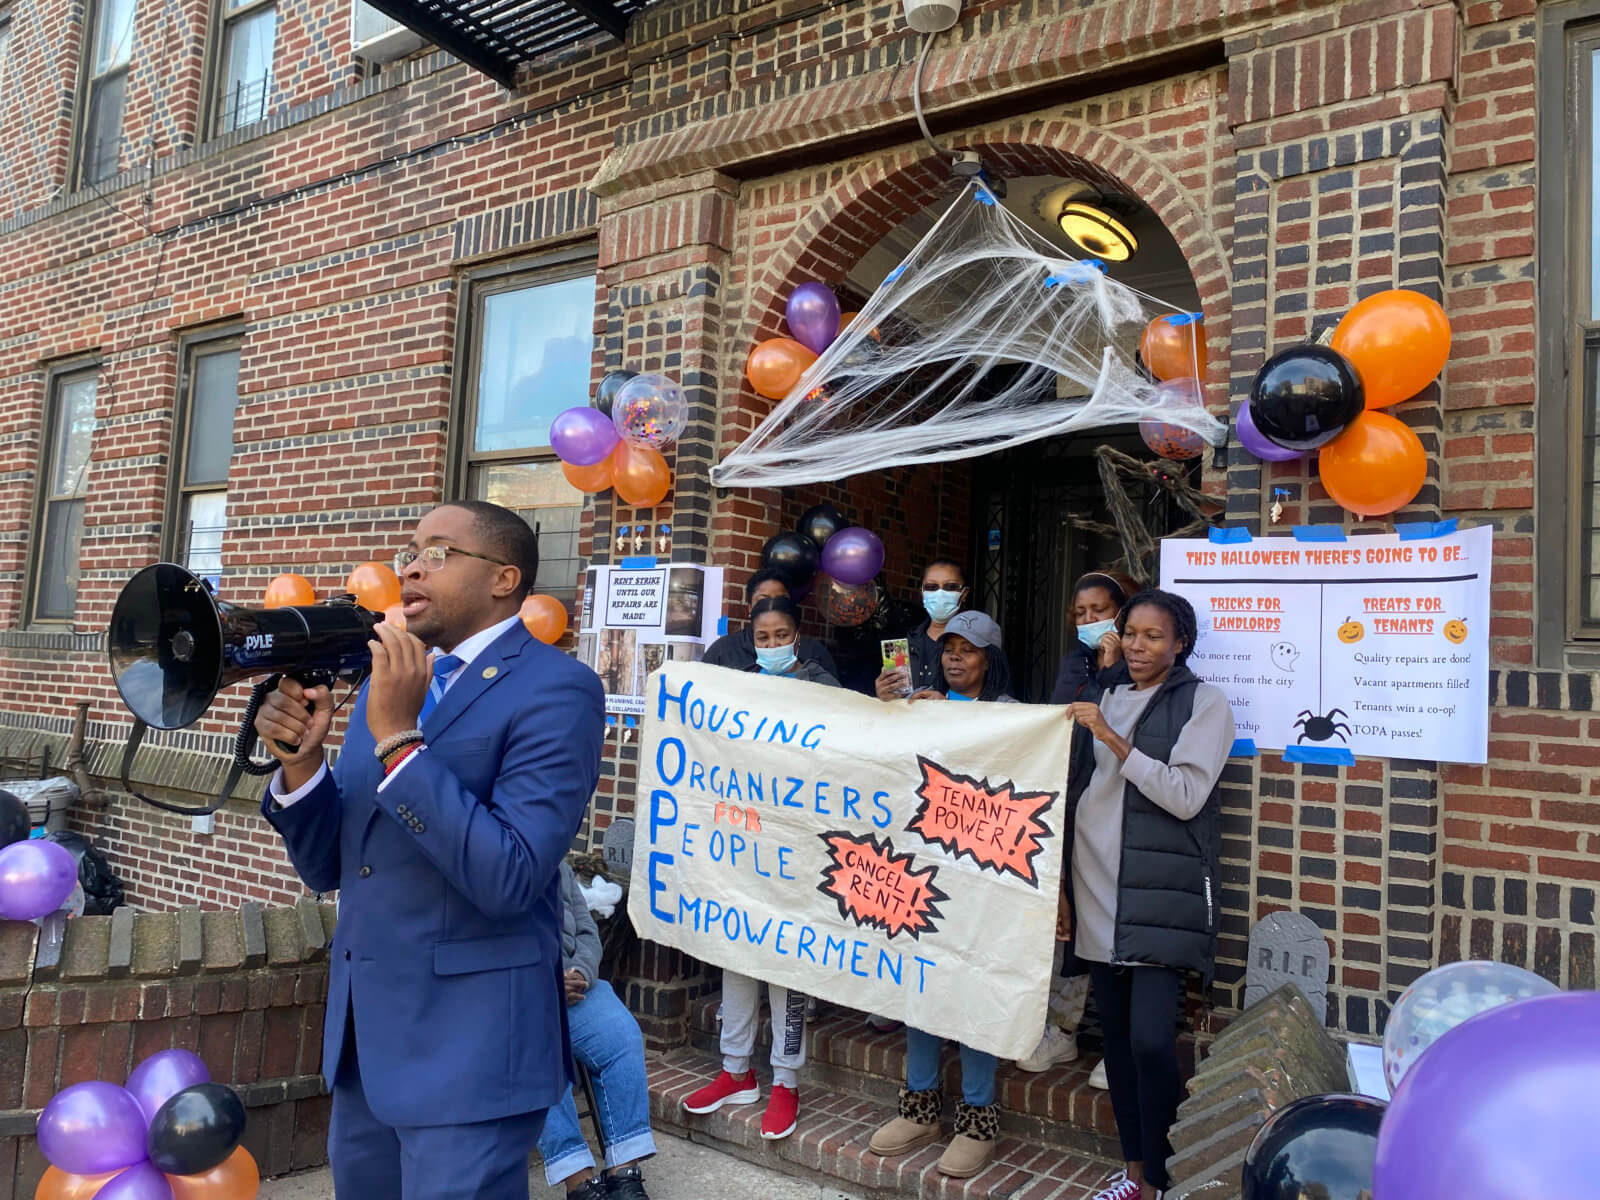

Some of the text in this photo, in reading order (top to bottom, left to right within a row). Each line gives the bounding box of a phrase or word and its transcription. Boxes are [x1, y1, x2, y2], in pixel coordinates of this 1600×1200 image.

[1186, 551, 1217, 566] THIS
[1221, 550, 1300, 566] HALLOWEEN
[1305, 549, 1361, 565] THERE'S
[1366, 547, 1413, 563] GOING
[1418, 547, 1438, 562] TO
[1209, 597, 1281, 610] TRICKS FOR
[1363, 597, 1442, 611] TREATS FOR
[1213, 617, 1281, 631] LANDLORDS
[1374, 618, 1434, 633] TENANTS
[246, 634, 273, 650] PYLE
[1191, 650, 1252, 661] No more rent
[1354, 652, 1392, 666] Quality
[1395, 655, 1429, 666] repairs
[1432, 656, 1447, 664] are
[1233, 674, 1255, 684] from
[1258, 675, 1272, 685] the
[1276, 677, 1294, 688] city
[1354, 676, 1470, 691] Vacant apartments filled
[657, 673, 826, 751] HOUSING
[1353, 700, 1393, 712] Tenants
[1396, 704, 1415, 713] win
[1427, 704, 1456, 718] co-op!
[1352, 724, 1423, 740] TOPA passes!
[656, 737, 893, 829] ORGANIZERS
[940, 785, 1018, 826] TENANT
[714, 801, 762, 834] FOR
[650, 789, 796, 881] PEOPLE
[935, 806, 1026, 856] POWER!
[845, 850, 905, 894] CANCEL
[850, 873, 921, 918] RENT!
[648, 850, 936, 994] EMPOWERMENT
